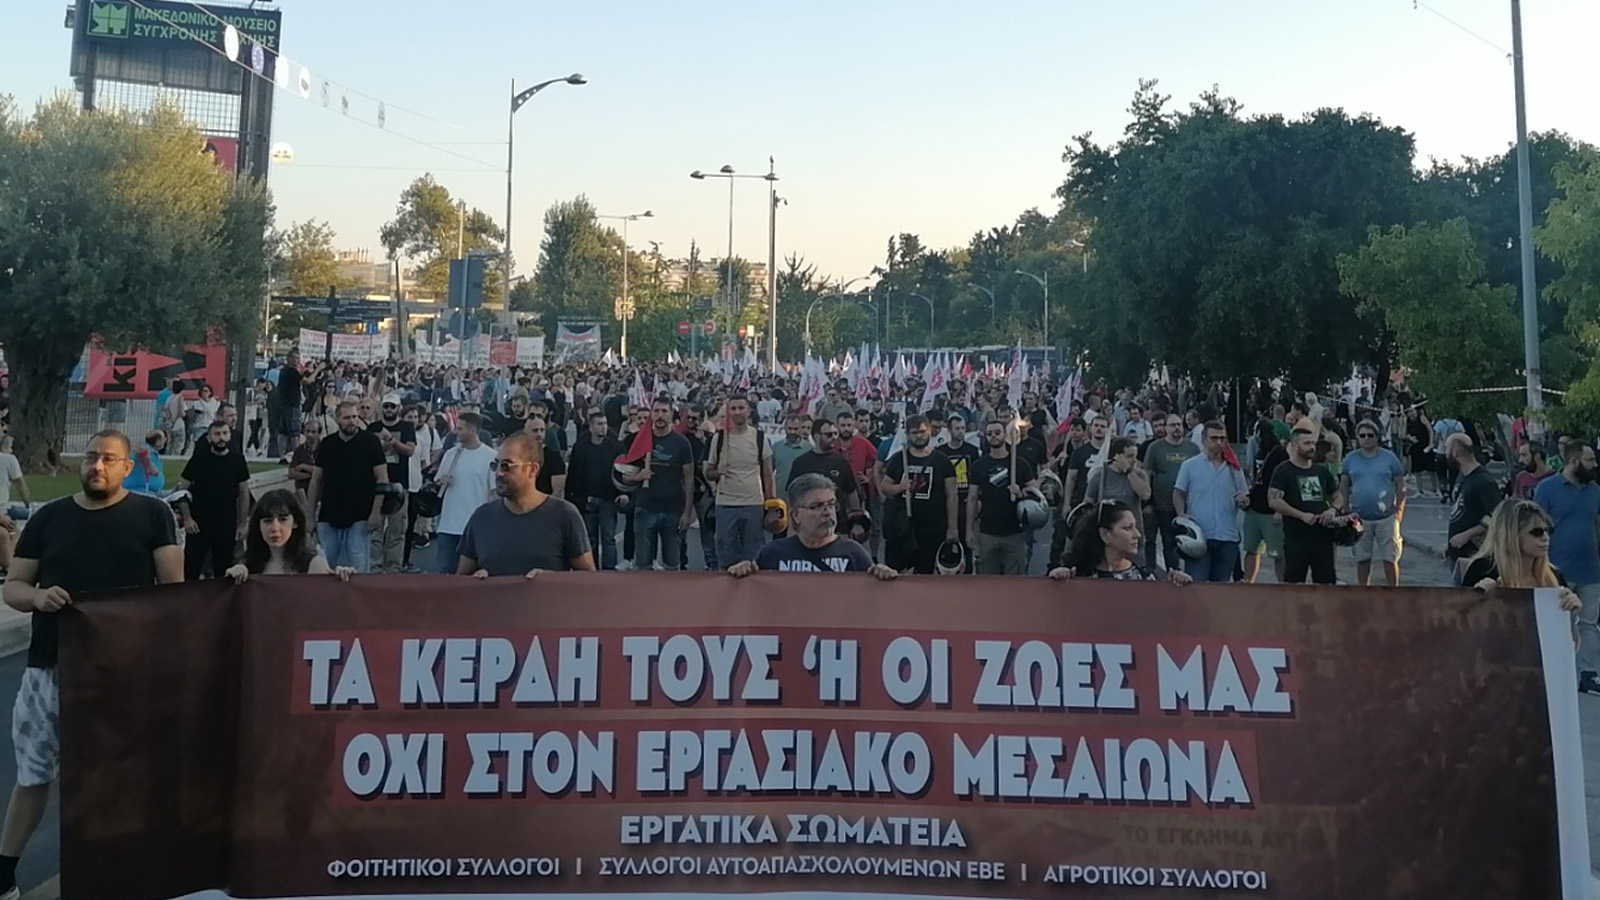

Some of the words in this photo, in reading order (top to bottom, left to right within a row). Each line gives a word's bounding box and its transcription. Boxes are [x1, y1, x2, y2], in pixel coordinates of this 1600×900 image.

[133, 7, 218, 26] ΜΑΚΕΔΟΝΙΚΟ
[223, 15, 277, 32] ΜΟΥΣΕΙΟ
[133, 23, 218, 43] ΣΥΓΧΡΟΝΗΣ
[303, 638, 376, 705] ΤΑ
[400, 635, 599, 704] ΚΕΡΔΗ
[622, 634, 780, 701] ΤΟΥΣ
[881, 636, 949, 704] ΟΙ
[972, 640, 1136, 709] ΖΩΕΣ
[1156, 643, 1292, 713] ΜΑΣ
[342, 732, 445, 796] ΟΧΙ
[462, 730, 615, 794] ΣΤΟΝ
[636, 728, 932, 795] ΕΡΓΑΣΙΑΚΟ
[953, 732, 1251, 804] ΜΕΣΑΙΩΝΑ
[620, 814, 779, 845] ΕΡΓΑΤΙΚΑ
[786, 813, 967, 848] ΣΩΜΑΤΕΙΑ
[327, 857, 452, 878] ΦΟΙΤΗΤΙΚΟΙ
[457, 857, 560, 877] ΣΥΛΛΟΓΟΙ
[599, 856, 701, 876] ΣΥΛΛΟΓΟΙ
[706, 855, 960, 878] ΑΥΤΟΑΠΑΣΧΟΛΟΥΜΕΝΩΝ
[967, 862, 1006, 881] ΕΒΕ
[1043, 865, 1156, 886] ΑΓΡΟΤΙΚΟΙ
[1161, 868, 1267, 890] ΣΥΛΛΟΓΟΙ
